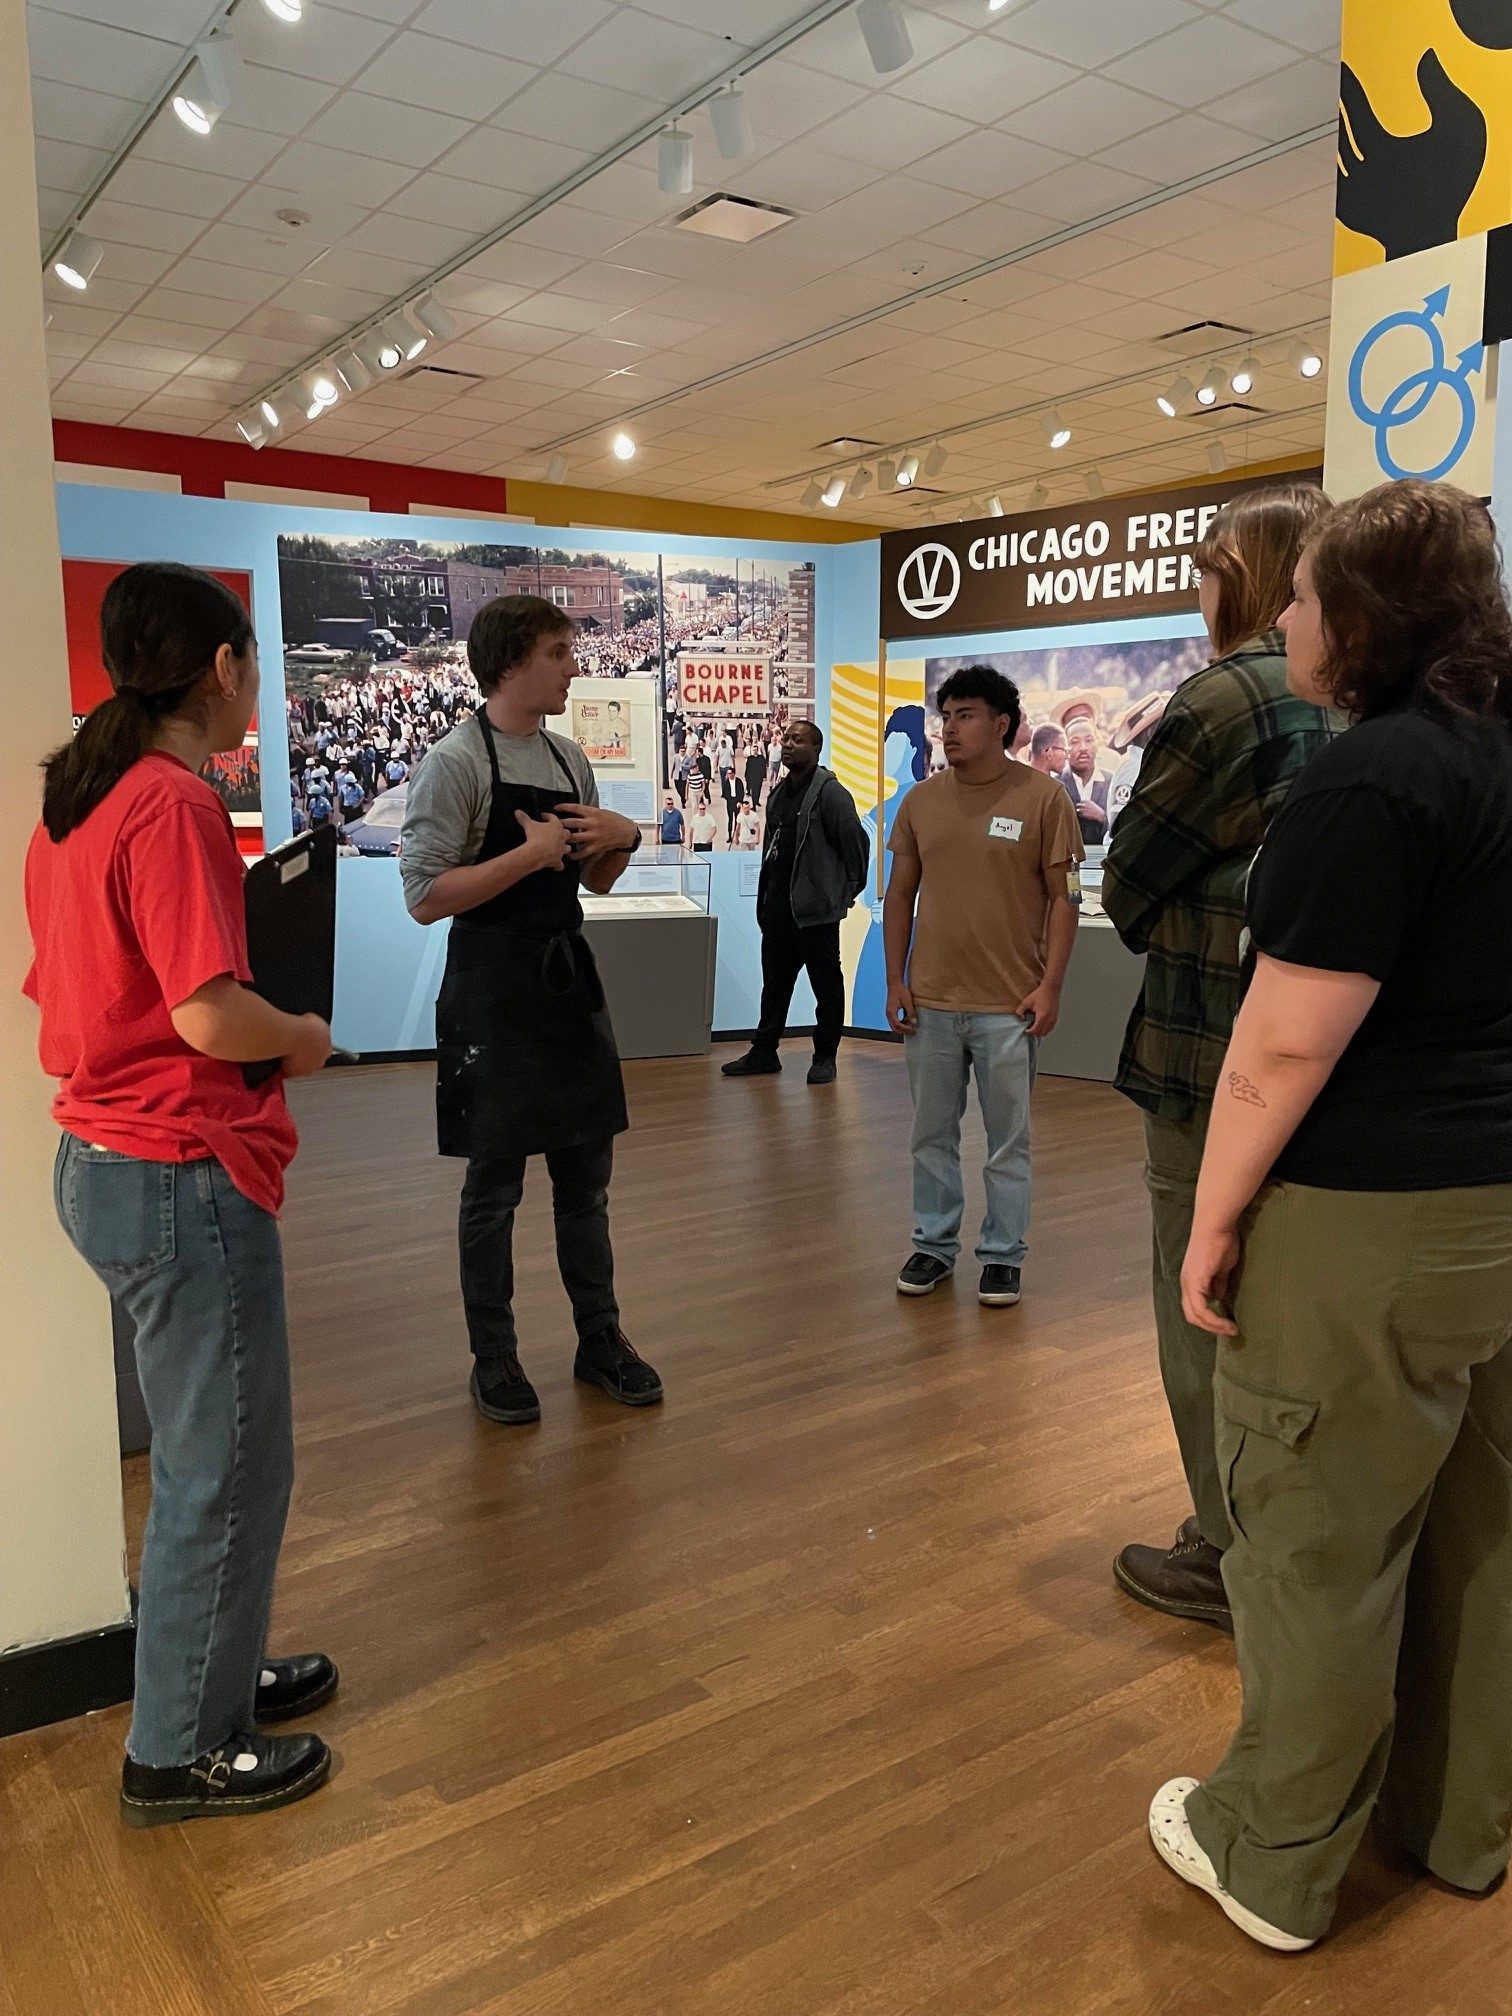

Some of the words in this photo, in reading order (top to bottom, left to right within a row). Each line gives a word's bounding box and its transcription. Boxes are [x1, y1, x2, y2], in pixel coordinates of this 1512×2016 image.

[968, 521, 1110, 570] CHICAGO
[1127, 503, 1229, 551] FREE
[1026, 554, 1196, 607] MOVEMEN
[685, 663, 764, 680] BOURNE
[683, 683, 767, 704] CHAPEL
